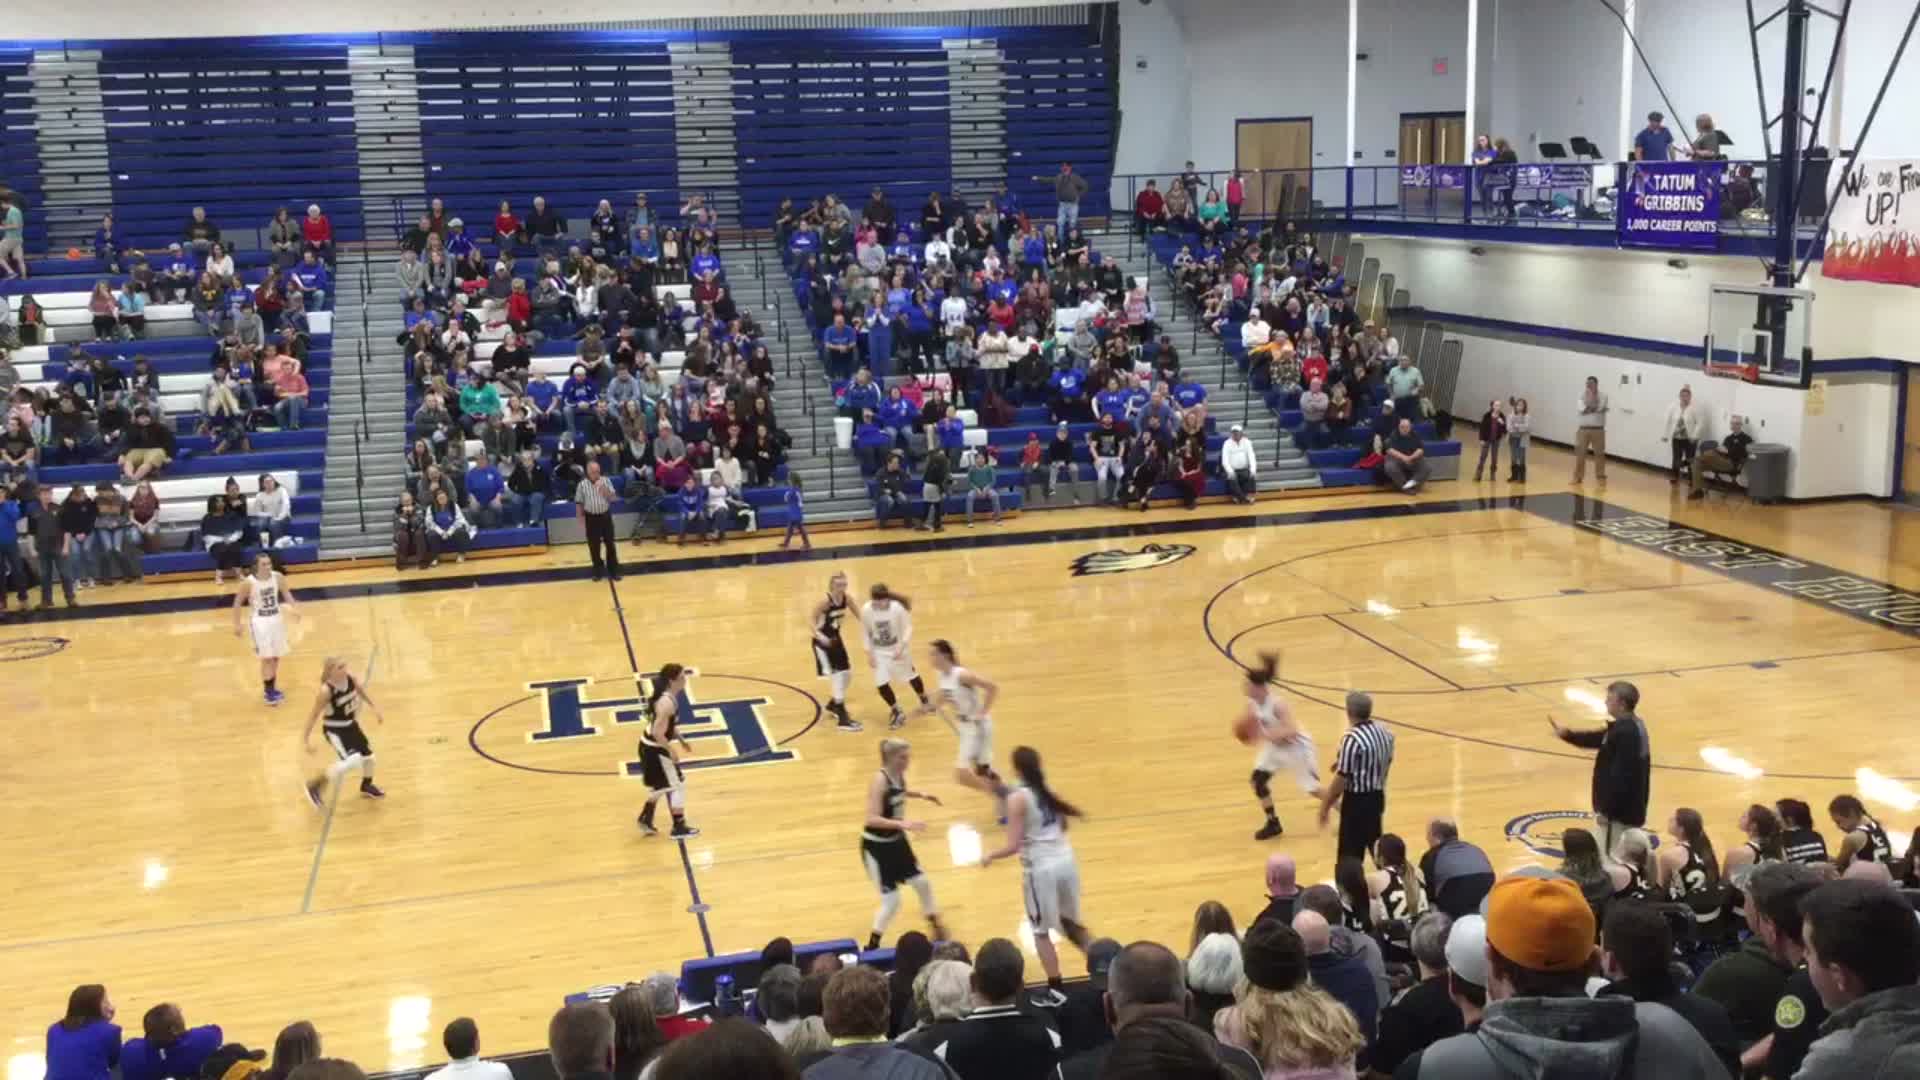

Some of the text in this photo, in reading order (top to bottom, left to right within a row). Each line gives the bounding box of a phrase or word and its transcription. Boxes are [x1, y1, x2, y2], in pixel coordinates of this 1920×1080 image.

[1653, 174, 1696, 192] TATUM
[1643, 195, 1705, 212] GRIBBINS
[1865, 190, 1901, 226] UP!
[1626, 218, 1717, 233] 1,000 CAREER POINTS
[1575, 515, 1808, 570] EAST
